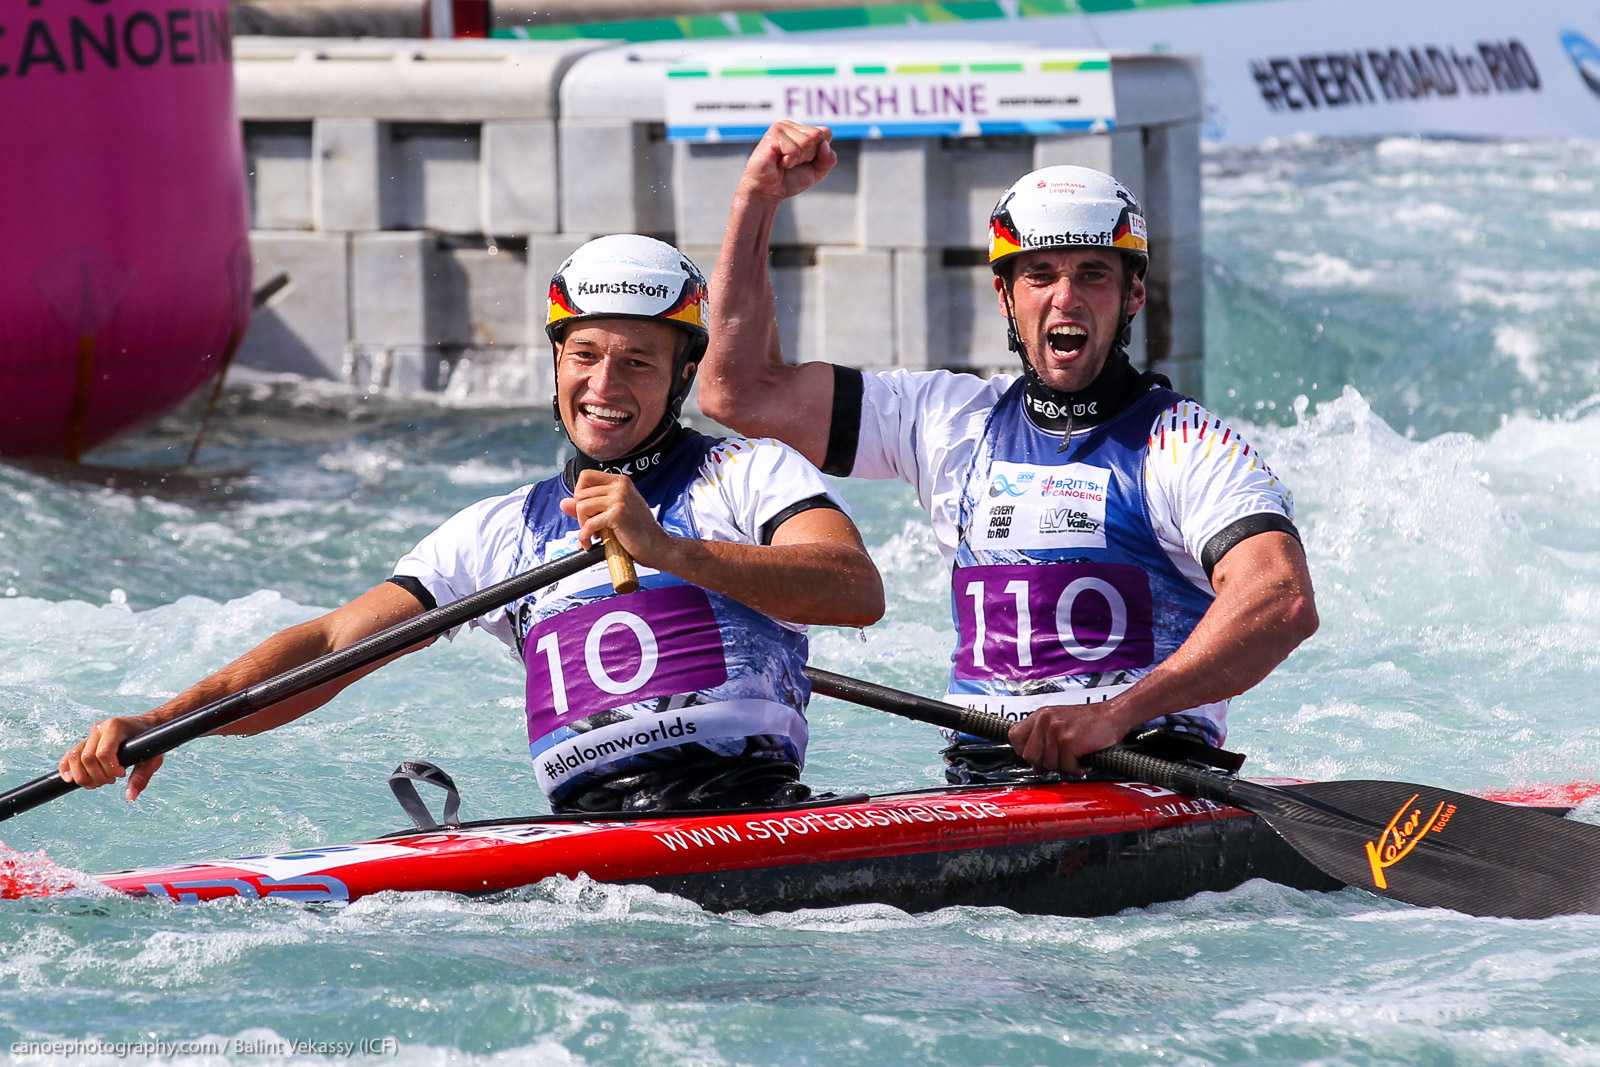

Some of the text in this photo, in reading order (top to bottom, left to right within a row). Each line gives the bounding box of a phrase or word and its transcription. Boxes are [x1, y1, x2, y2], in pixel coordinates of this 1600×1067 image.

[0, 9, 232, 80] ANOEIN
[1249, 38, 1543, 112] #EVERY ROAD to RIO
[785, 83, 989, 117] FINISH LINE
[1022, 231, 1112, 247] Kunststoff
[578, 280, 669, 298] Kunststoff
[1055, 478, 1104, 493] BRITISH
[1052, 490, 1103, 502] CANOEING
[989, 505, 1016, 516] #EVERY
[1067, 509, 1088, 519] Lee
[990, 516, 1012, 527] ROAD
[1066, 518, 1100, 531] Valley
[987, 528, 1010, 539] to RIO
[965, 576, 1128, 667] 110
[535, 610, 659, 716] 10
[544, 717, 697, 780] #slalomworlds
[653, 800, 1007, 852] www.sportausweis.de
